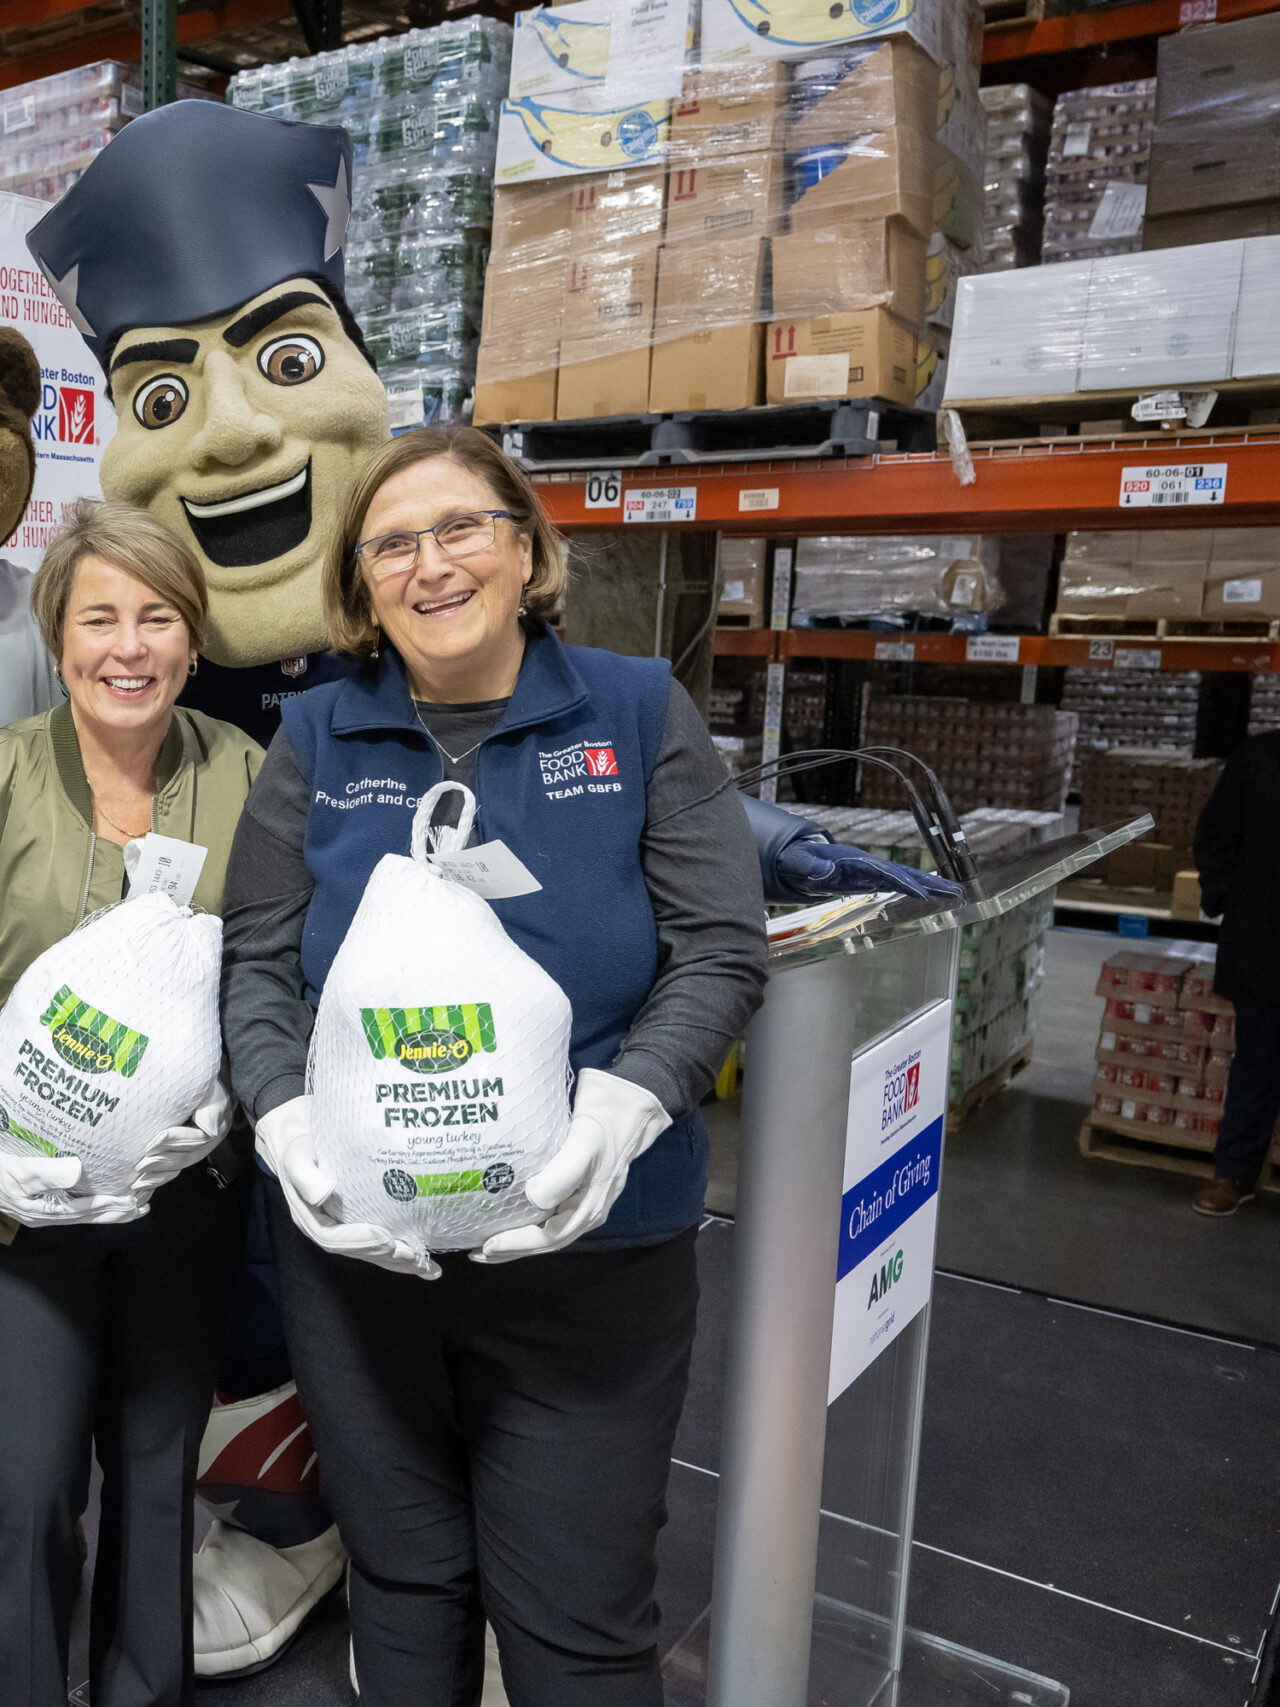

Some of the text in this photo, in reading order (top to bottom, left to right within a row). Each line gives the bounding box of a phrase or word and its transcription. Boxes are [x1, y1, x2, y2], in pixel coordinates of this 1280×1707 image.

[61, 369, 94, 386] Boston
[1146, 466, 1203, 478] 60-06-01
[588, 476, 618, 502] 06
[540, 751, 584, 771] FOOD
[553, 743, 582, 757] Greater
[542, 763, 587, 784] BANK
[346, 778, 407, 794] Catherine
[545, 782, 622, 800] TEAM GBFB
[315, 790, 373, 809] President
[377, 793, 403, 805] and
[19, 1039, 120, 1113] PREMIUM
[13, 1061, 103, 1128] FROZEN
[375, 1077, 504, 1103] PREMIUM
[883, 1073, 906, 1106] FOOD
[384, 1101, 499, 1129] FROZEN
[881, 1096, 904, 1131] BANK
[407, 1131, 481, 1149] young turkey
[849, 1153, 931, 1239] Chain of Giving
[867, 1249, 904, 1311] AMG
